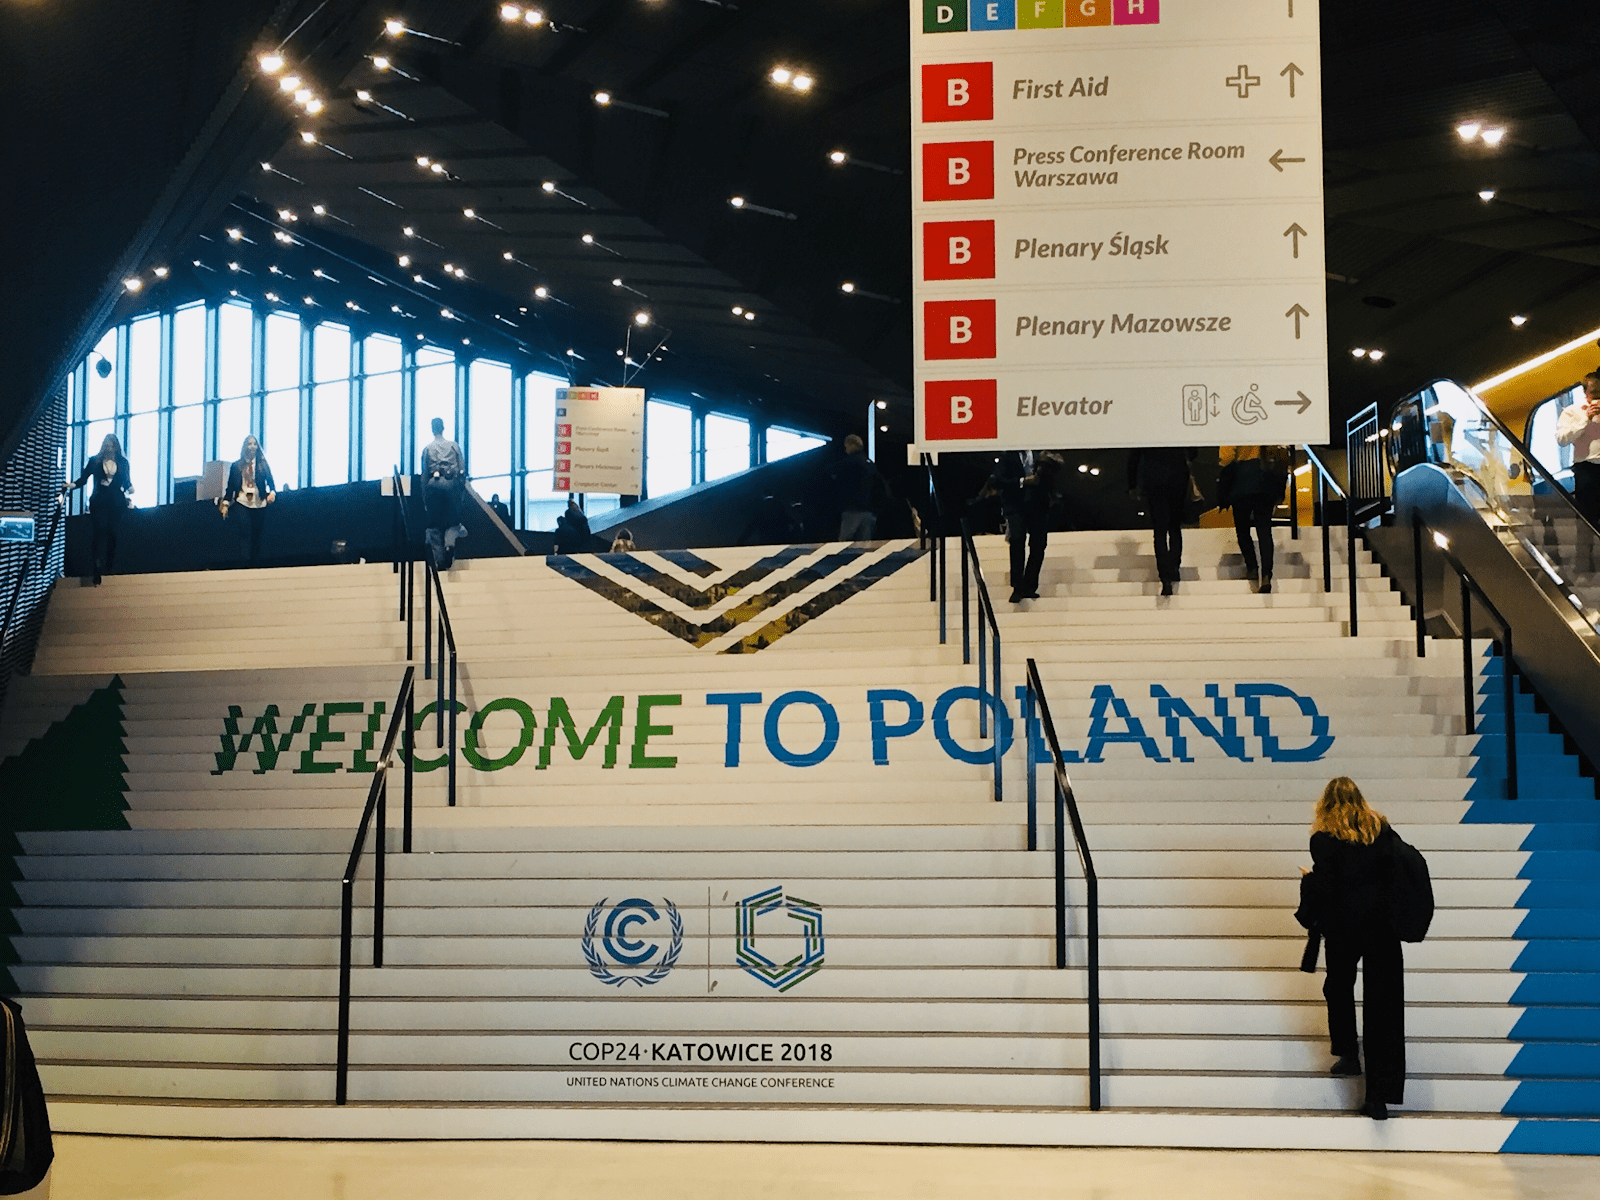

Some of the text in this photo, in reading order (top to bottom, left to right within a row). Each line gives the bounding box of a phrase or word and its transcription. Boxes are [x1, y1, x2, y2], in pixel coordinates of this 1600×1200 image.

[937, 0, 1145, 24] D E F G H
[947, 75, 1109, 107] B First Aid
[948, 141, 1245, 186] B Press Conference Room
[1014, 169, 1119, 188] Warszawa
[948, 231, 1170, 265] B Plenary Śląsk
[949, 313, 1232, 344] B Plenary Mazowsze
[950, 395, 1114, 424] B Elevator
[209, 682, 1337, 776] WELCOME TO POLAND
[780, 1043, 833, 1062] 2018
[566, 1076, 835, 1089] UNITED NATIONS CLIMATE CHANGE CONFERENCE
